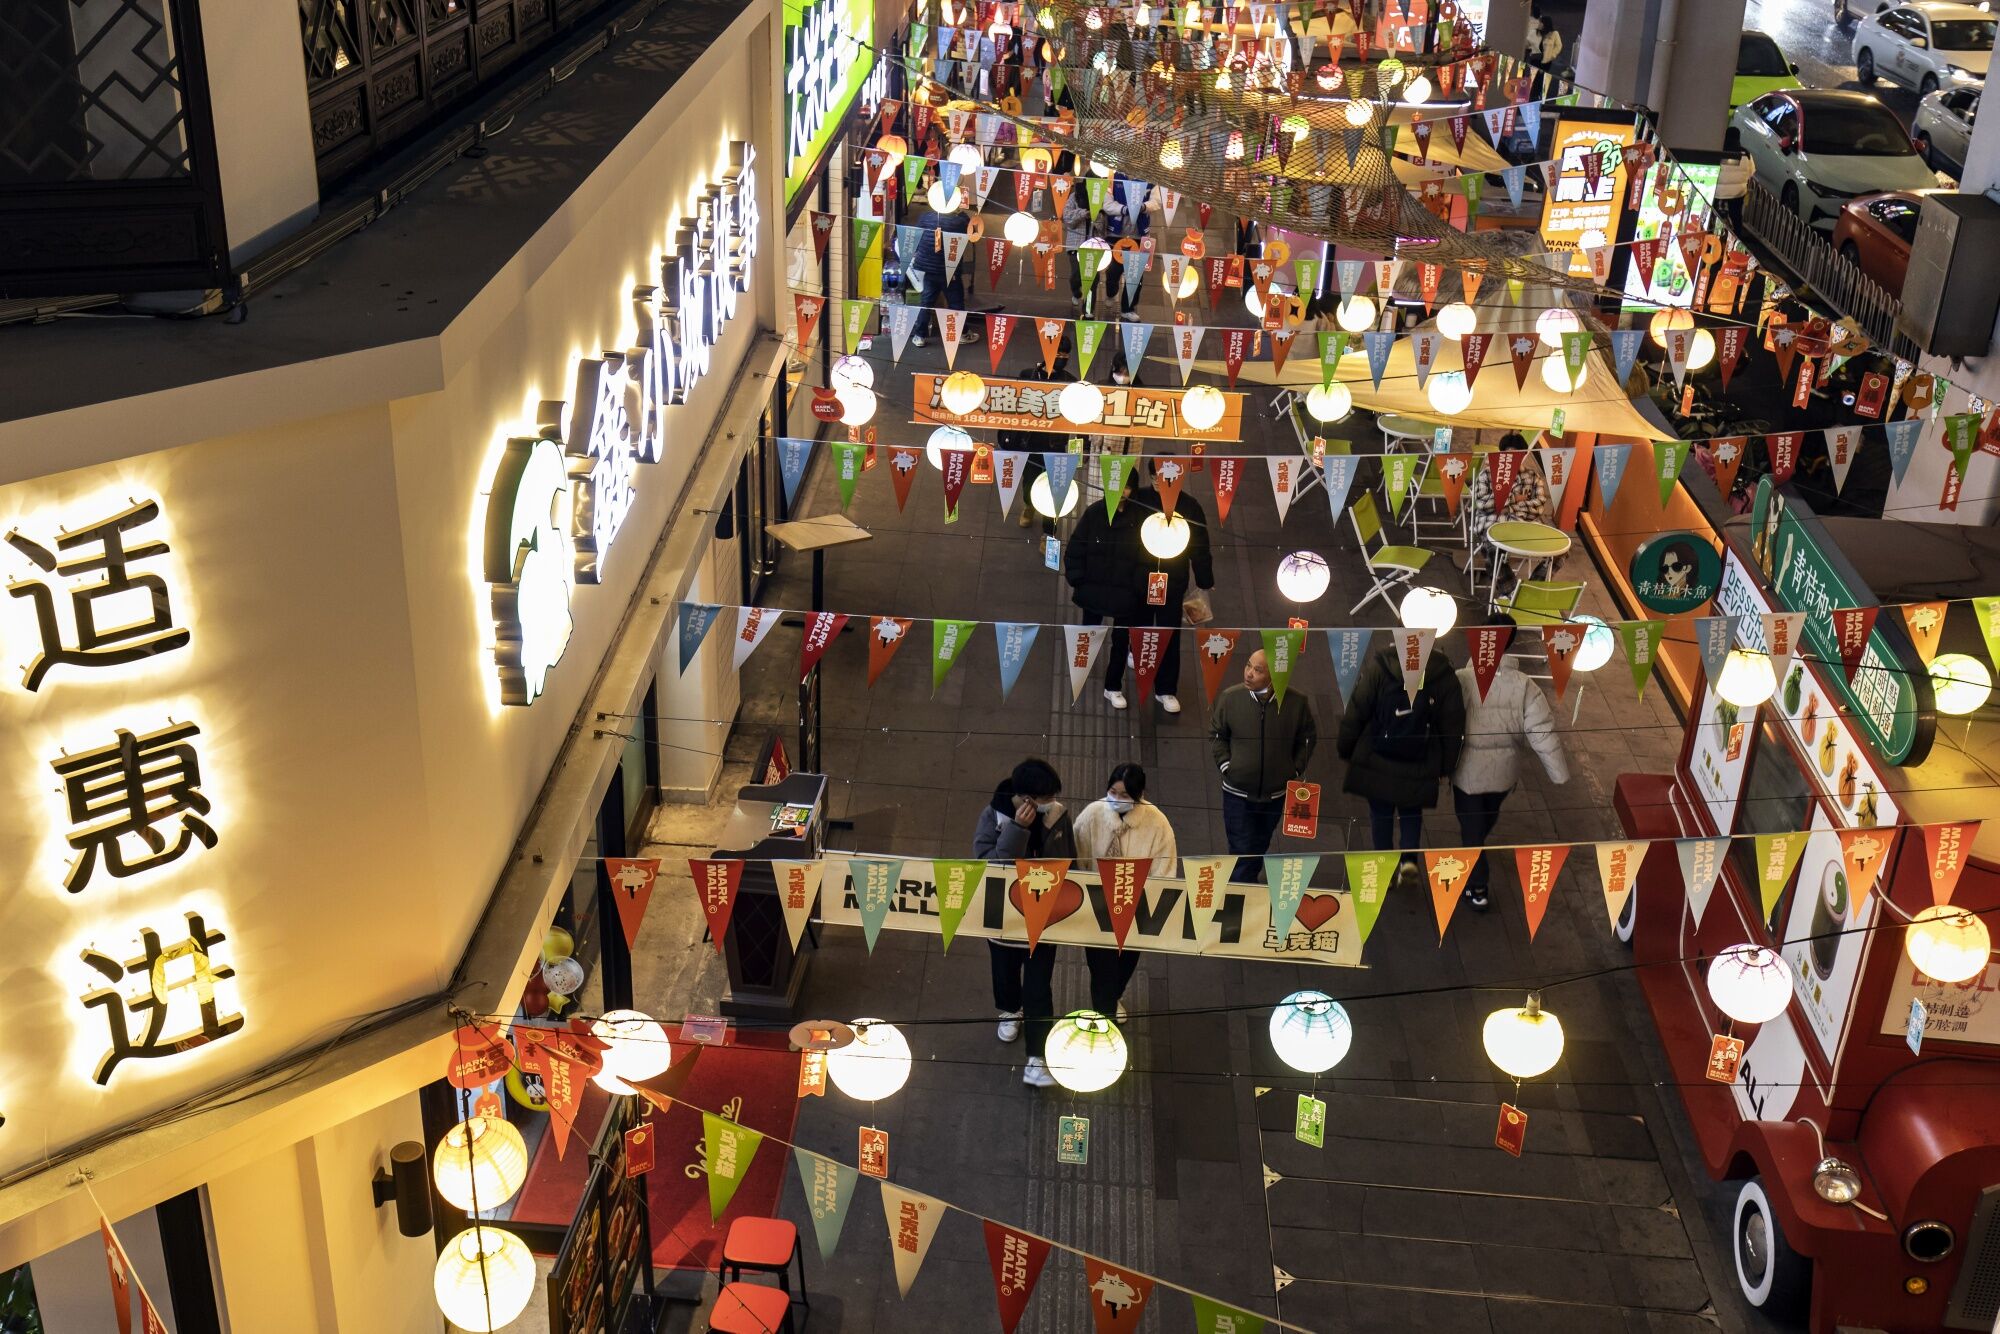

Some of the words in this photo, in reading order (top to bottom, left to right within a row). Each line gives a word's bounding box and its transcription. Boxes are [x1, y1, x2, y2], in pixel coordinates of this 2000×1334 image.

[990, 316, 999, 345] MALL
[996, 317, 1007, 347] MARK
[1229, 331, 1237, 360] MALL
[1235, 331, 1243, 361] MARK
[1722, 329, 1730, 358] MALL
[1729, 329, 1738, 360] MARK
[1466, 335, 1474, 363] MALL
[1473, 335, 1481, 365] MARK
[963, 413, 987, 424] 188
[988, 415, 1021, 426] 2709
[1021, 417, 1054, 428] 5427
[947, 452, 957, 482] MALL
[1496, 453, 1505, 483] MALL
[1775, 436, 1784, 465] MALL
[1782, 437, 1792, 468] MARK
[954, 453, 964, 485] MARK
[1218, 458, 1228, 489] MALL
[1226, 459, 1235, 492] MARK
[1502, 453, 1513, 486] MARK
[808, 611, 828, 642] MALL
[815, 611, 836, 648] MARK
[1003, 624, 1015, 659] MALL
[1011, 624, 1025, 662] MARK
[1708, 620, 1718, 655] MALL
[1716, 620, 1728, 657] MARK
[1843, 612, 1855, 646] MALL
[1852, 612, 1864, 648] MARK
[1139, 632, 1150, 667] MALL
[1148, 632, 1159, 669] MARK
[1341, 632, 1351, 667] MALL
[1348, 632, 1359, 669] MARK
[1478, 631, 1488, 666] MALL
[1486, 631, 1497, 668] MARK
[1694, 842, 1705, 883] MALL
[1703, 840, 1716, 884] MARK
[1938, 828, 1951, 868] MALL
[1948, 827, 1962, 870] MARK
[706, 864, 718, 903] MALL
[718, 864, 729, 906] MARK
[866, 864, 878, 902] MALL
[877, 864, 888, 905] MARK
[1114, 863, 1125, 904] MALL
[1123, 862, 1135, 905] MARK
[1281, 858, 1292, 899] MALL
[1290, 858, 1303, 901] MARK
[1529, 851, 1541, 891] MALL
[1539, 850, 1552, 892] MARK
[455, 1055, 487, 1071] MARK
[456, 1063, 486, 1078] MALL
[549, 1057, 561, 1096] MALL
[558, 1061, 572, 1105] MARK
[814, 1159, 826, 1207] MALL
[824, 1163, 837, 1214] MARK
[1001, 1234, 1016, 1285] MALL
[1013, 1239, 1029, 1292] MARK
